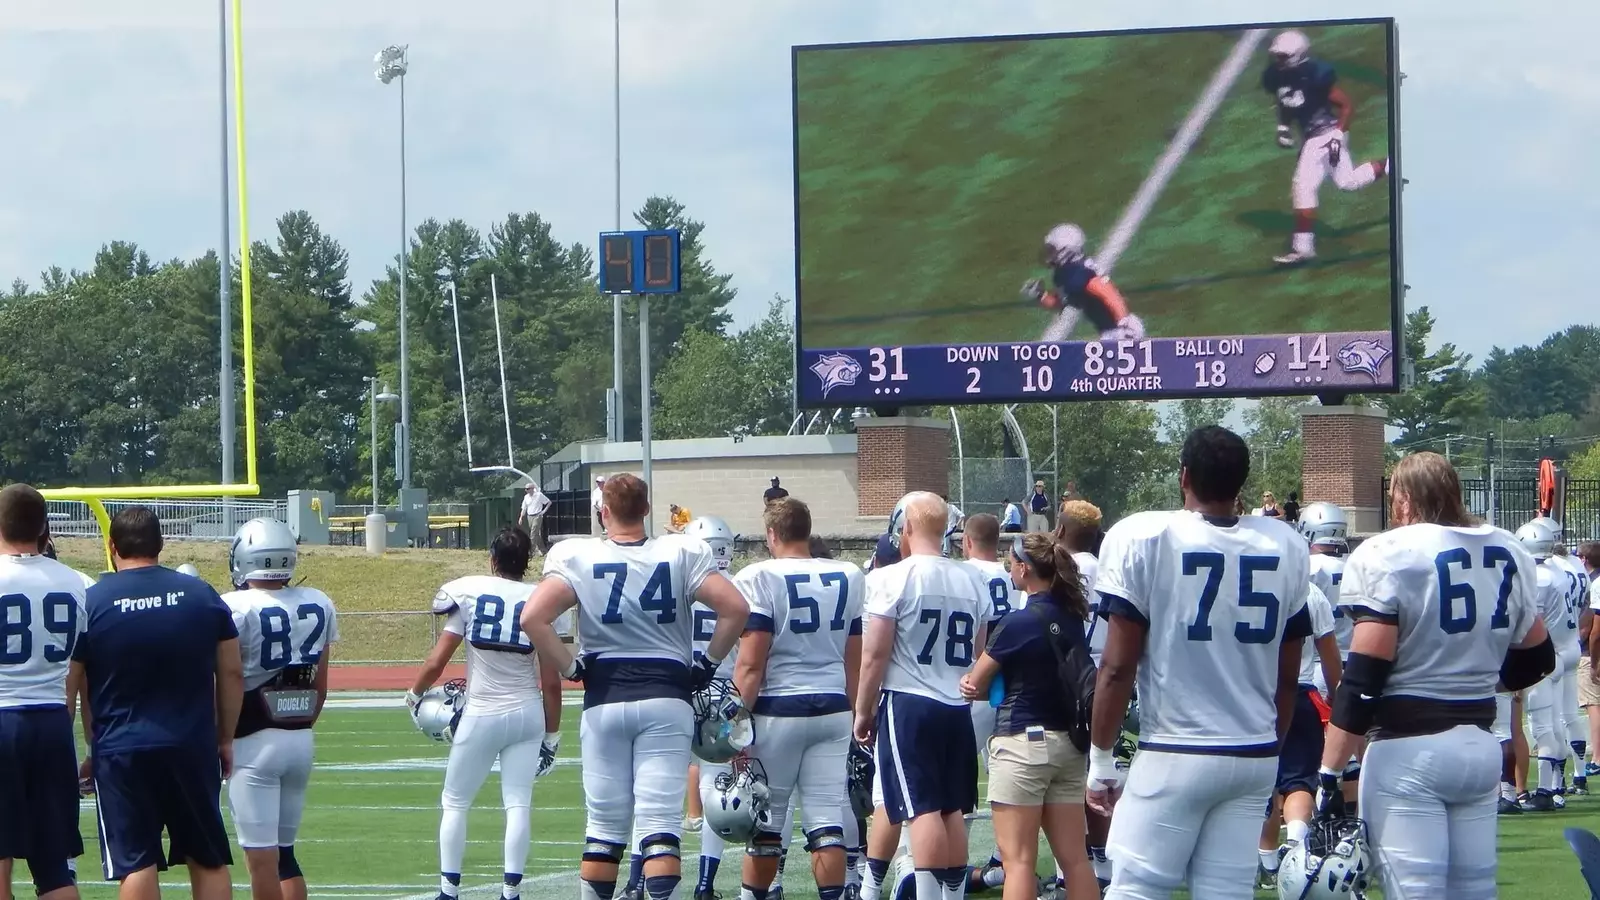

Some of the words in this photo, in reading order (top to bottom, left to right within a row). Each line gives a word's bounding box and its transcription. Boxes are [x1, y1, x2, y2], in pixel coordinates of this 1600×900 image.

[869, 346, 908, 382] 31
[947, 346, 999, 363] DOWN
[1011, 346, 1034, 361] TO
[1036, 344, 1061, 361] GO
[1084, 339, 1158, 377] 8:51
[1175, 341, 1216, 356] BALL
[1222, 339, 1244, 355] ON
[1287, 334, 1331, 371] 14
[966, 367, 981, 393] 2
[1022, 365, 1053, 392] 10
[1070, 378, 1093, 392] 4th
[1096, 376, 1162, 392] QUARTER
[1195, 360, 1226, 387] 18
[593, 562, 676, 624] 74
[784, 572, 848, 633] 57
[1182, 552, 1280, 644] 75
[1435, 546, 1517, 634] 67
[0, 592, 78, 665] 89
[259, 603, 325, 670] 82
[917, 608, 974, 667] 78
[277, 697, 310, 712] DOUGLAS
